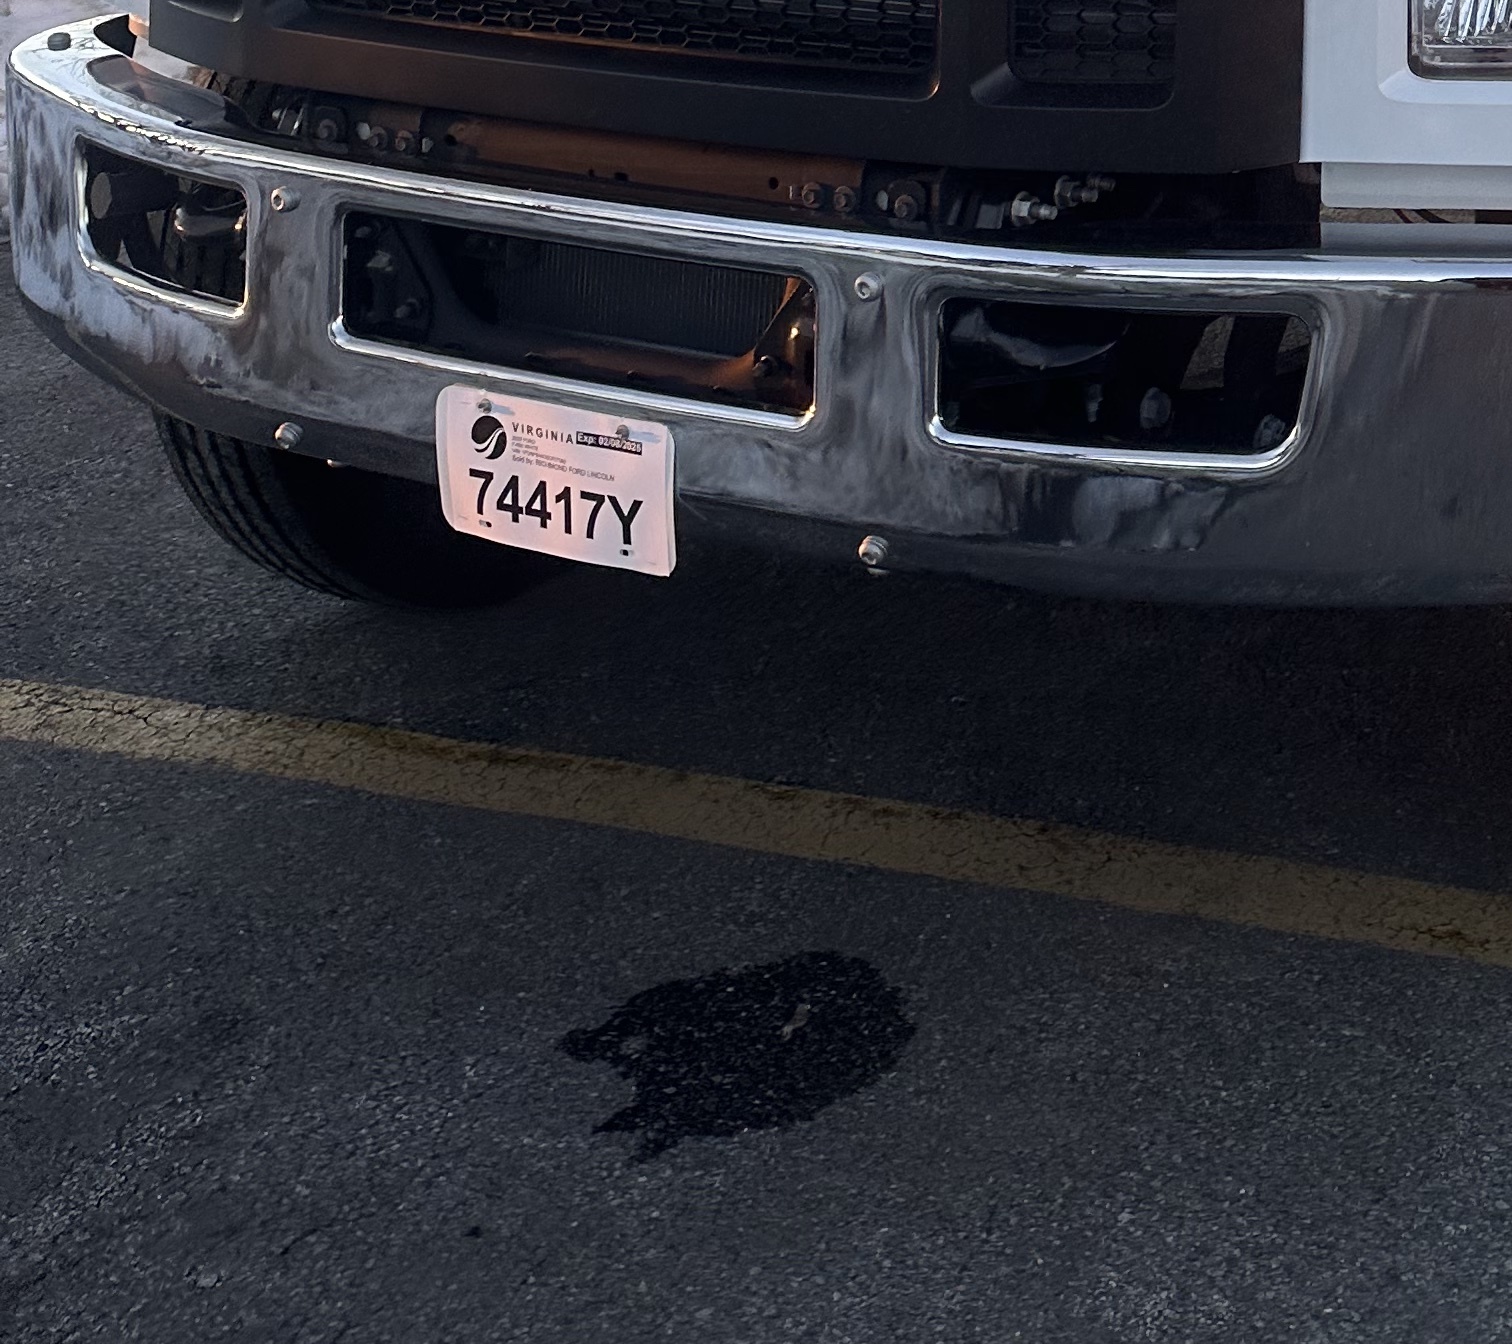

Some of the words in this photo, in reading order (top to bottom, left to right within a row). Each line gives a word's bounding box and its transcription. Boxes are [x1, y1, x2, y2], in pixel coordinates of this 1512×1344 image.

[511, 422, 574, 444] VIRGINIA
[577, 433, 597, 446] Exp:
[469, 468, 643, 546] 74417Y
